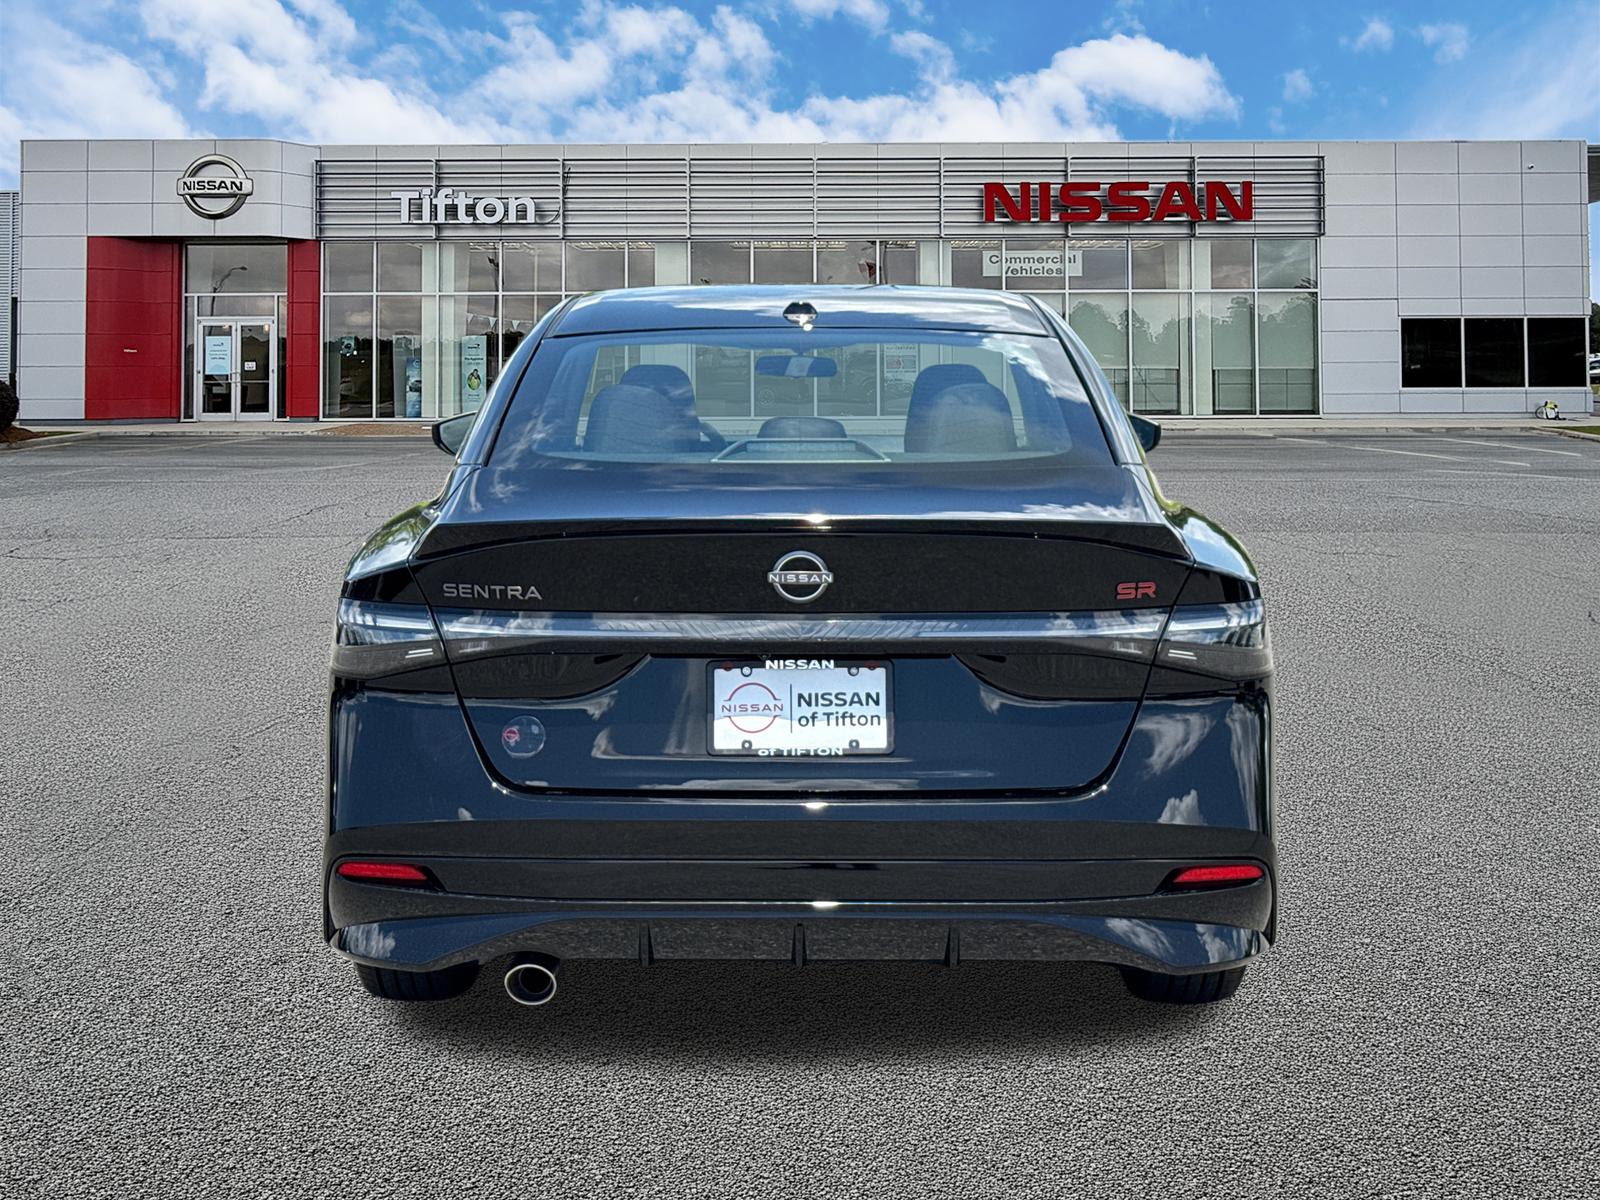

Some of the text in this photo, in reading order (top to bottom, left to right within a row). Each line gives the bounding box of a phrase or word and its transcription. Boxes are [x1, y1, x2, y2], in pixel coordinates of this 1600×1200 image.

[182, 180, 243, 192] NISSAN
[390, 187, 536, 225] Tifton
[983, 180, 1254, 223] NISSAN
[768, 573, 832, 584] NISSAN
[442, 583, 543, 600] SENTRA
[1116, 581, 1157, 600] SR
[765, 659, 835, 671] NISSAN
[797, 692, 880, 707] NISSAN
[721, 704, 784, 712] NISSAN
[798, 711, 881, 727] of Tifton
[780, 747, 843, 756] TIFTON
